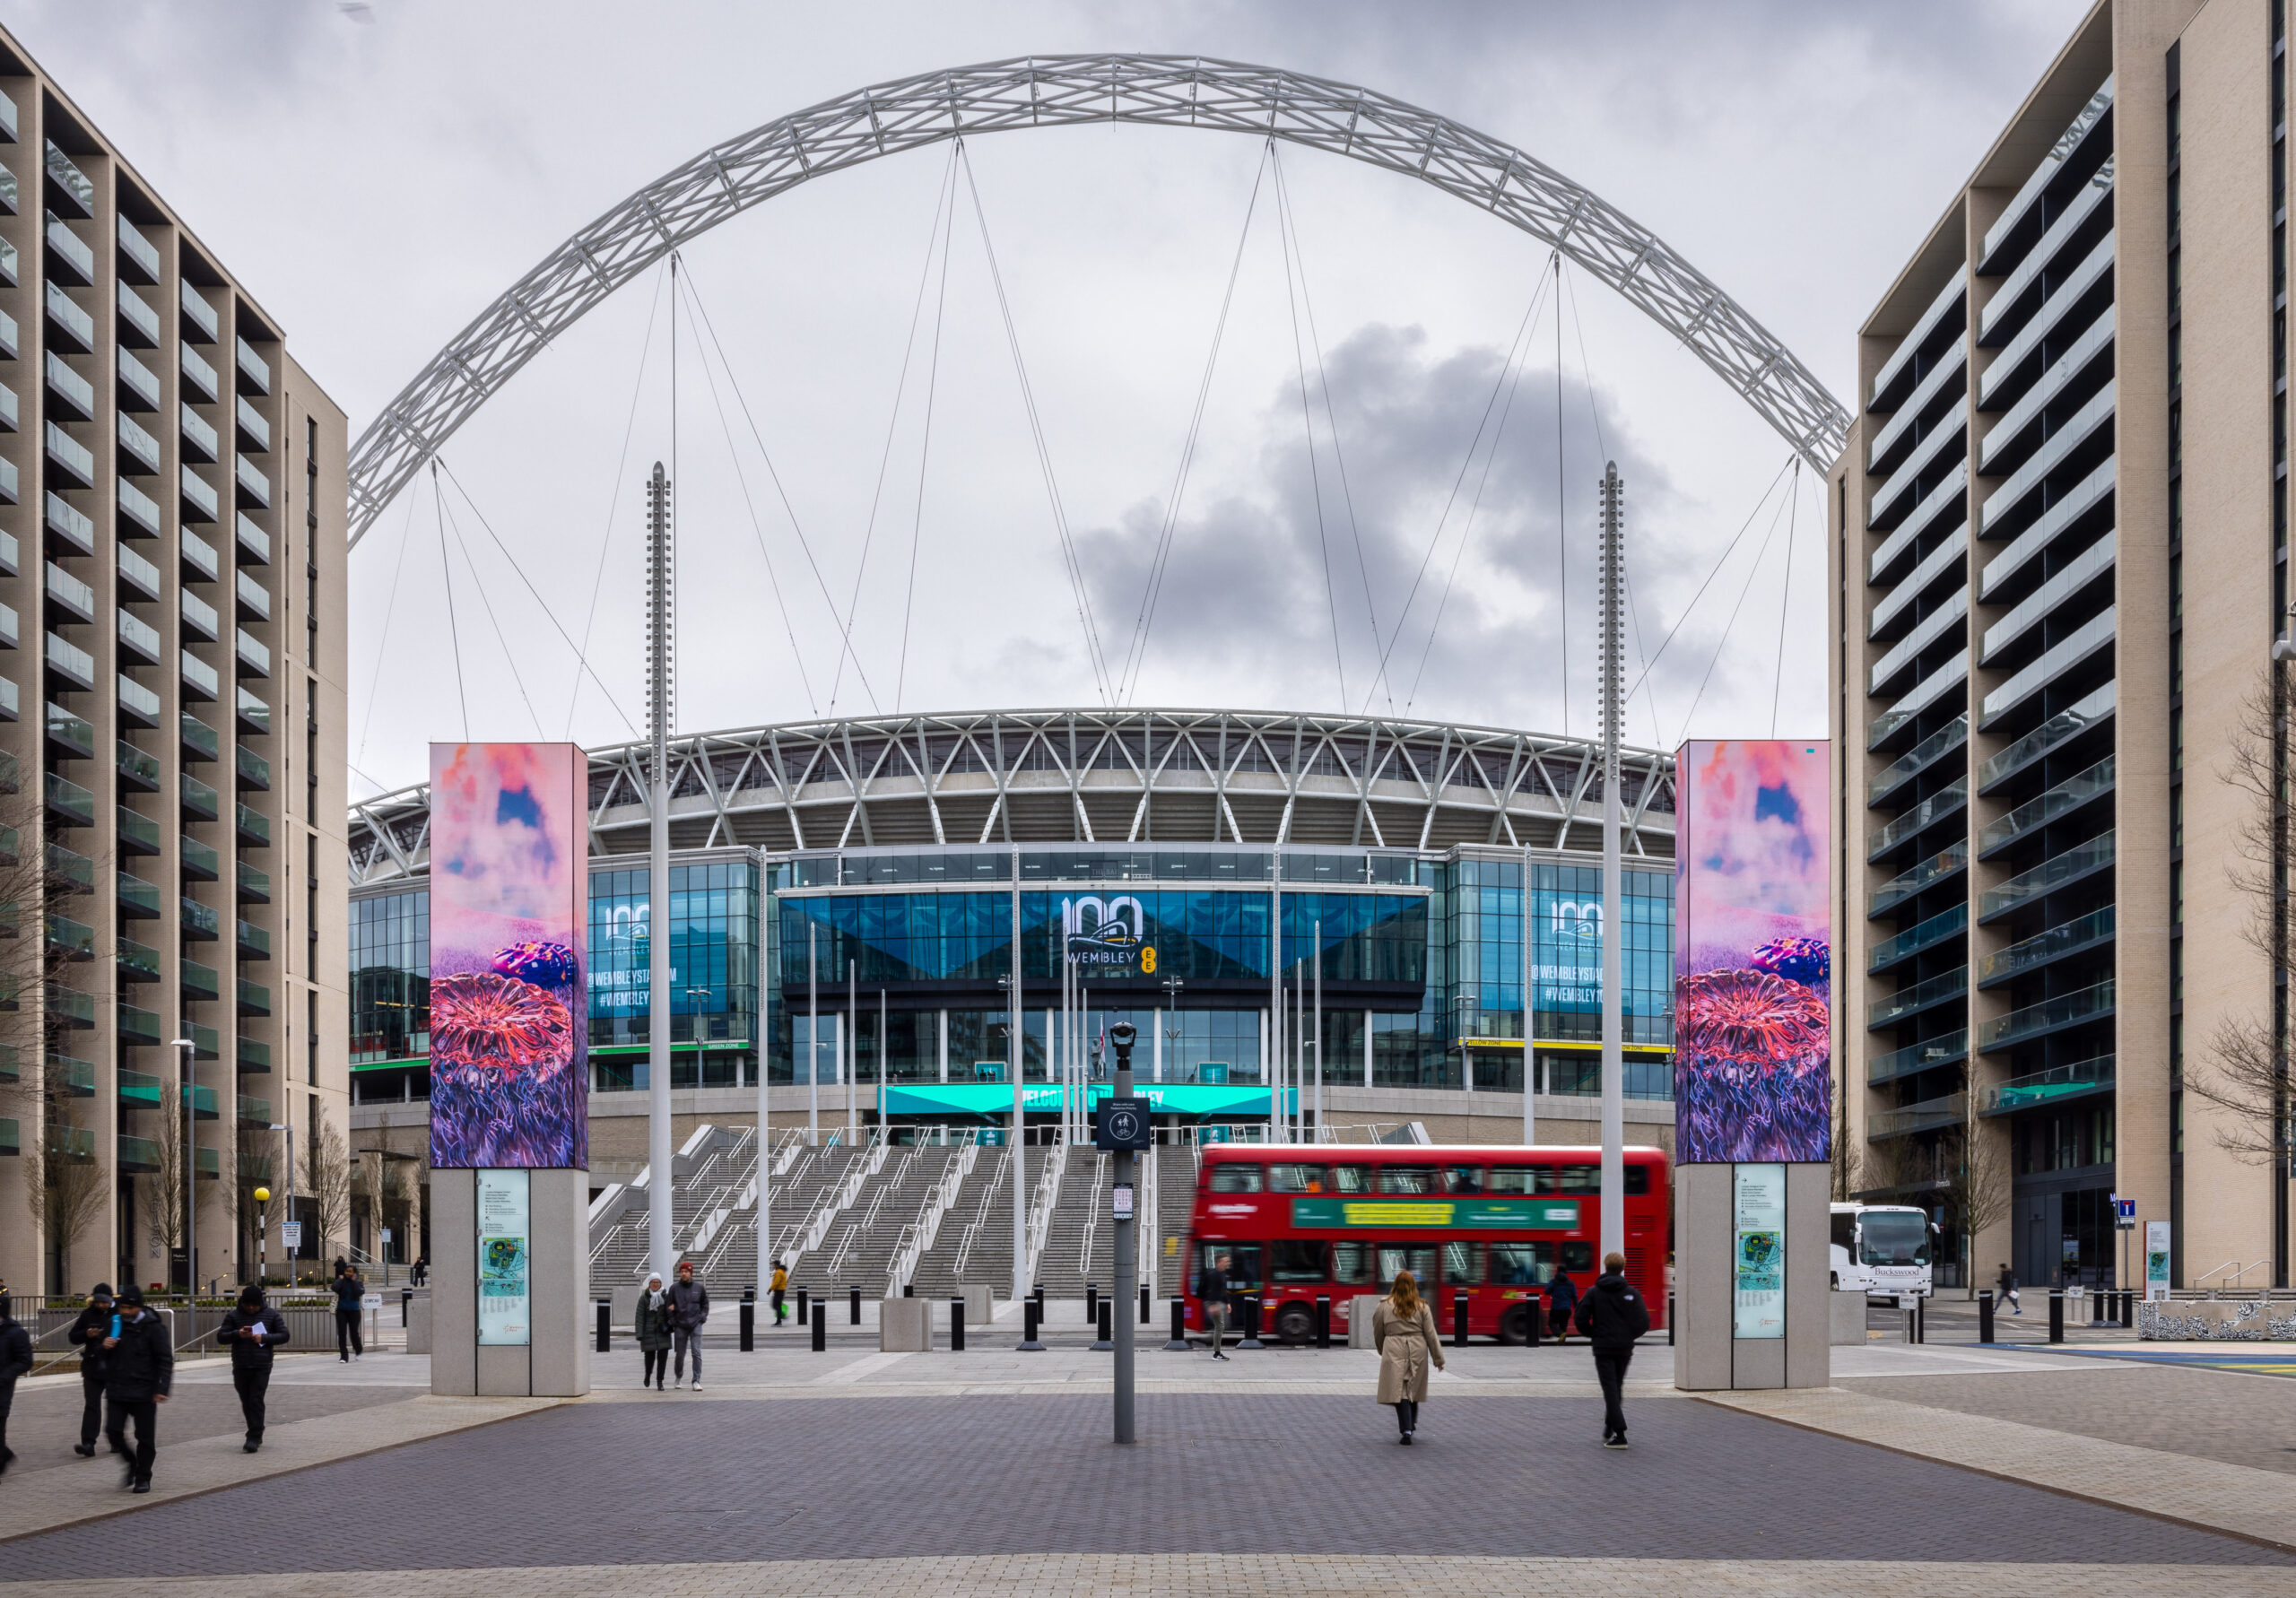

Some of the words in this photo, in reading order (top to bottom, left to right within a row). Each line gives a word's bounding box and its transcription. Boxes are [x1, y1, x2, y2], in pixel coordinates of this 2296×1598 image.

[605, 904, 650, 941] 100
[1062, 896, 1144, 942] 100
[1552, 900, 1604, 936] 100
[1067, 951, 1135, 963] WEMBLEY
[587, 968, 677, 987] @WEMBLEYSTAM
[599, 991, 650, 1007] #WEMBLEY
[1874, 1267, 1919, 1276] Buckswood
